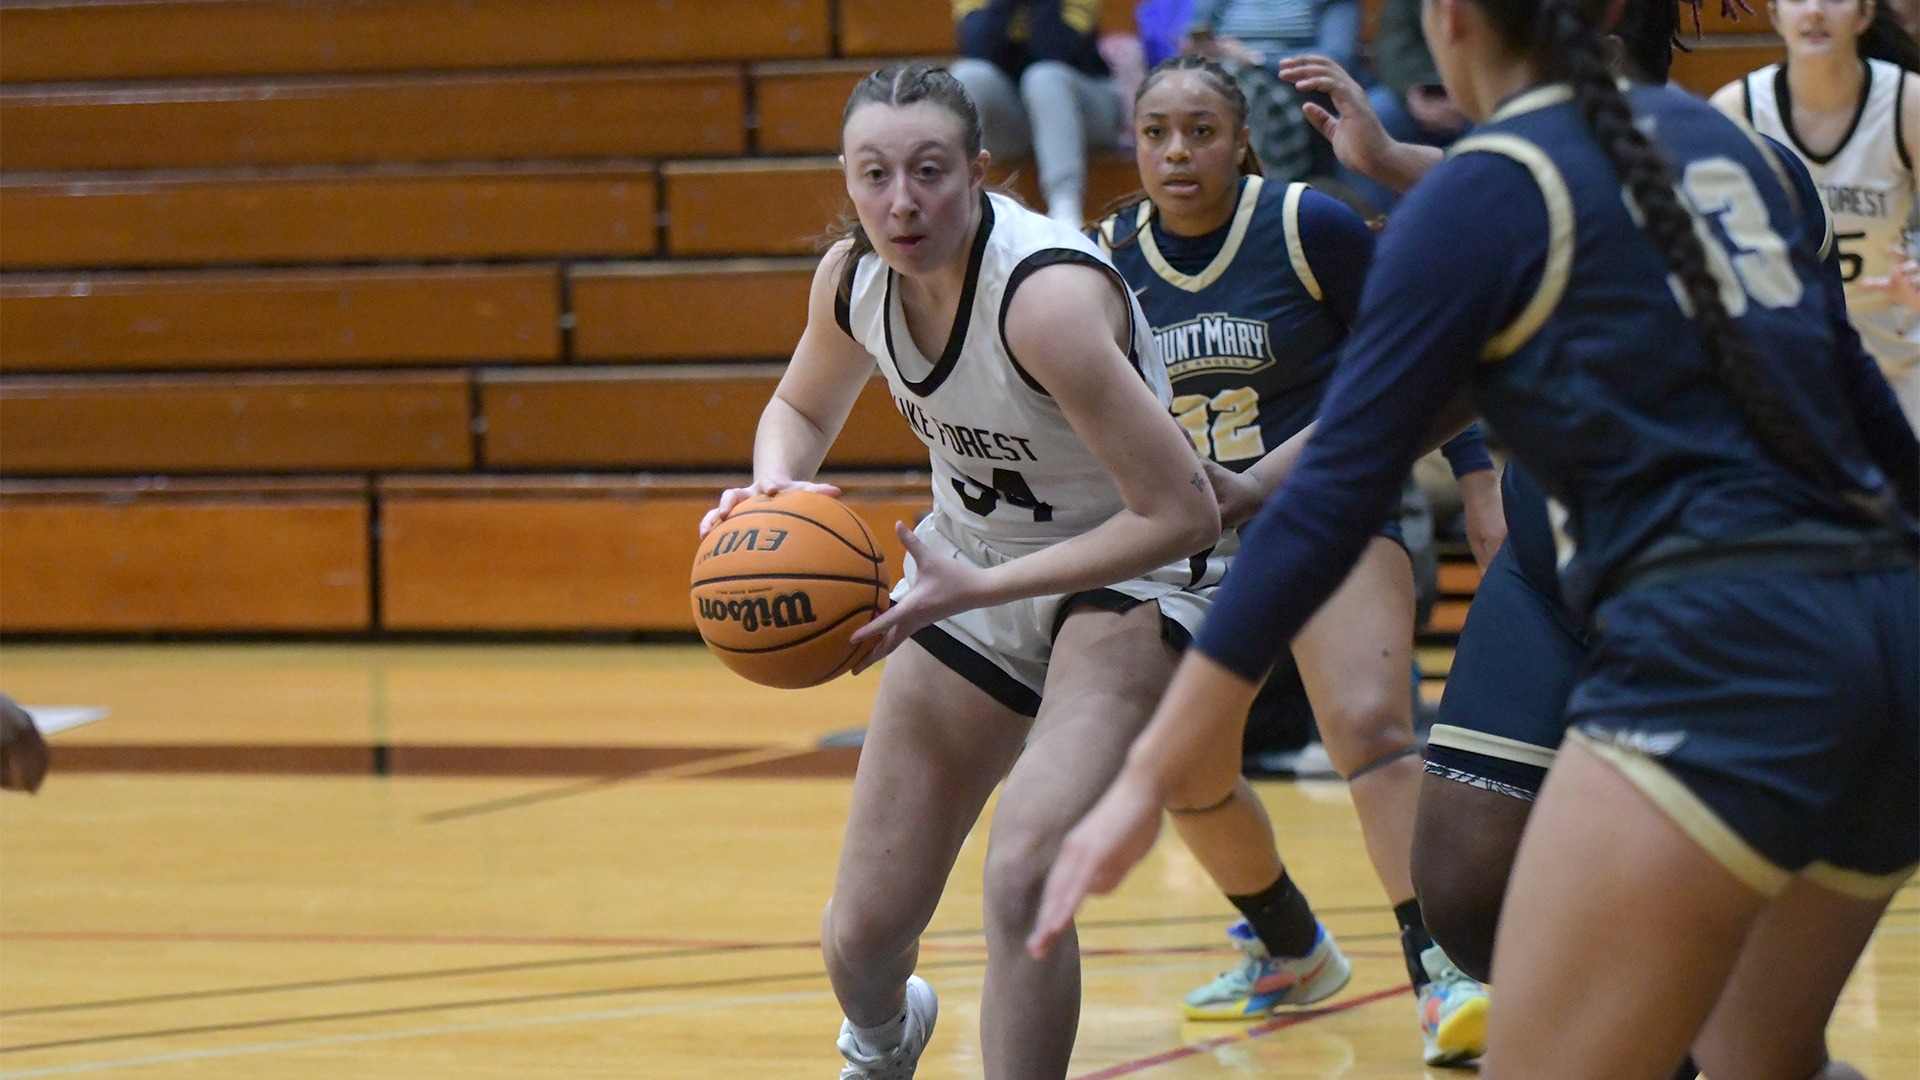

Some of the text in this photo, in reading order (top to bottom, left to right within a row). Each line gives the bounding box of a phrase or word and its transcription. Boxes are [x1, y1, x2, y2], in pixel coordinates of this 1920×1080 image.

[1818, 184, 1887, 218] OREST
[1154, 317, 1264, 365] OUNT MARY
[893, 395, 1038, 461] AKE FOREST
[1171, 386, 1266, 462] 32
[712, 529, 788, 557] EVO
[699, 591, 817, 632] Wilson
